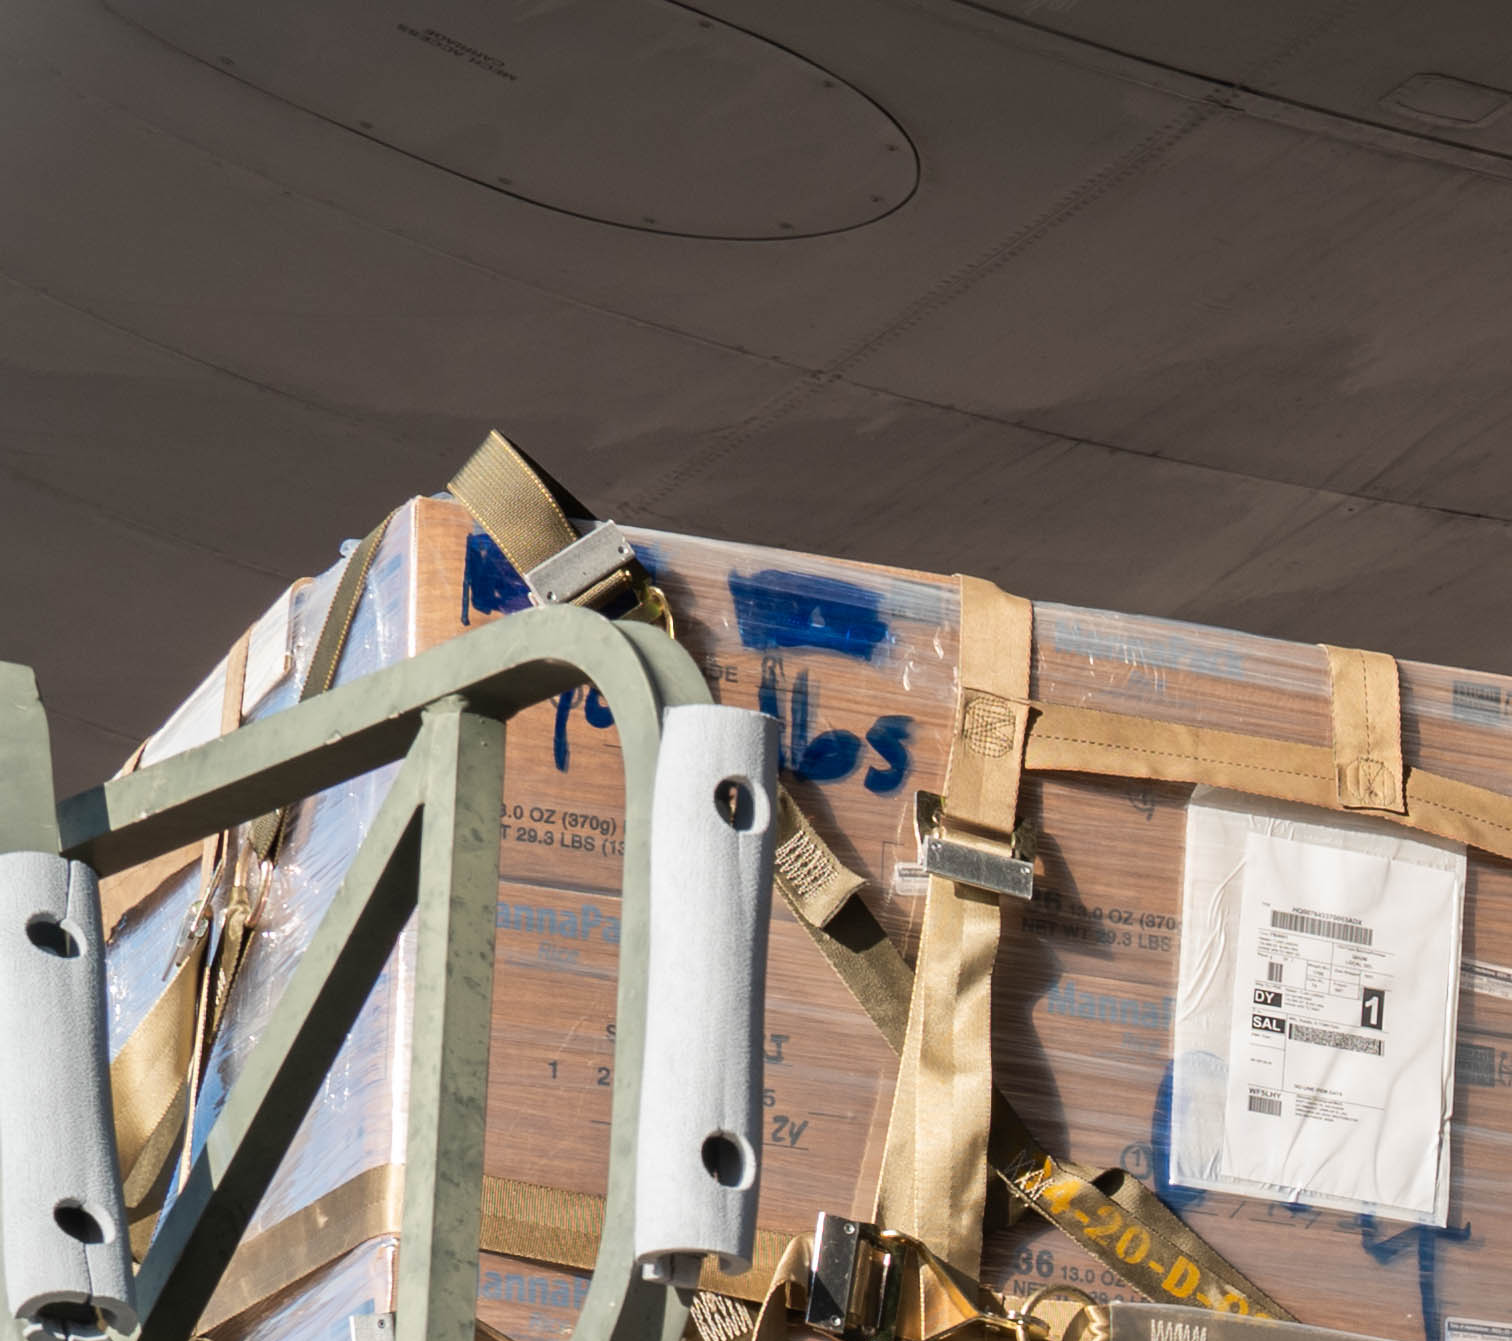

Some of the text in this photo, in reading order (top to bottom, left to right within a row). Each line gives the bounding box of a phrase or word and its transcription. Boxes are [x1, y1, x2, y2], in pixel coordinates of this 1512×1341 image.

[529, 807, 617, 836] OZ (370g)
[516, 826, 554, 845] 29.3
[561, 832, 596, 852] LBS
[496, 901, 620, 944] annaPa
[1138, 931, 1172, 951] LBS
[1255, 990, 1275, 1004] DY
[1252, 1016, 1281, 1032] SAL
[1364, 996, 1380, 1026] 1
[1013, 1248, 1055, 1279] 36
[1060, 1264, 1096, 1284] 13.0
